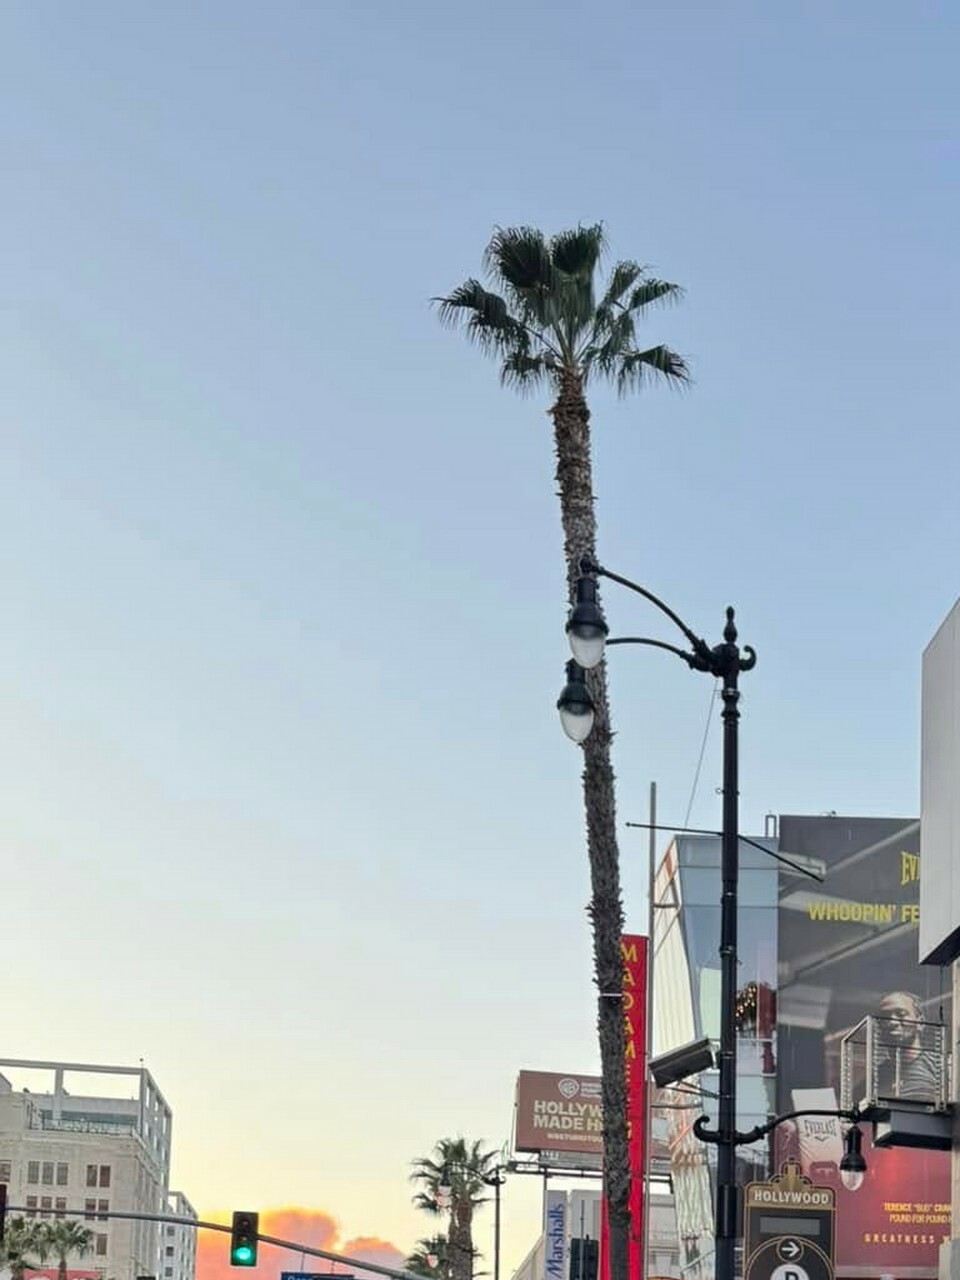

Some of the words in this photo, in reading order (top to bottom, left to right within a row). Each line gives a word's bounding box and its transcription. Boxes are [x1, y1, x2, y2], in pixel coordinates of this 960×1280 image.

[901, 849, 920, 886] EV
[808, 902, 896, 923] WHOOPIN'
[533, 1115, 584, 1130] MADE
[587, 1118, 604, 1131] H
[754, 1190, 829, 1204] HOLLYWOOD
[546, 1203, 564, 1279] Marshalls
[863, 1233, 935, 1244] GREATNESS
